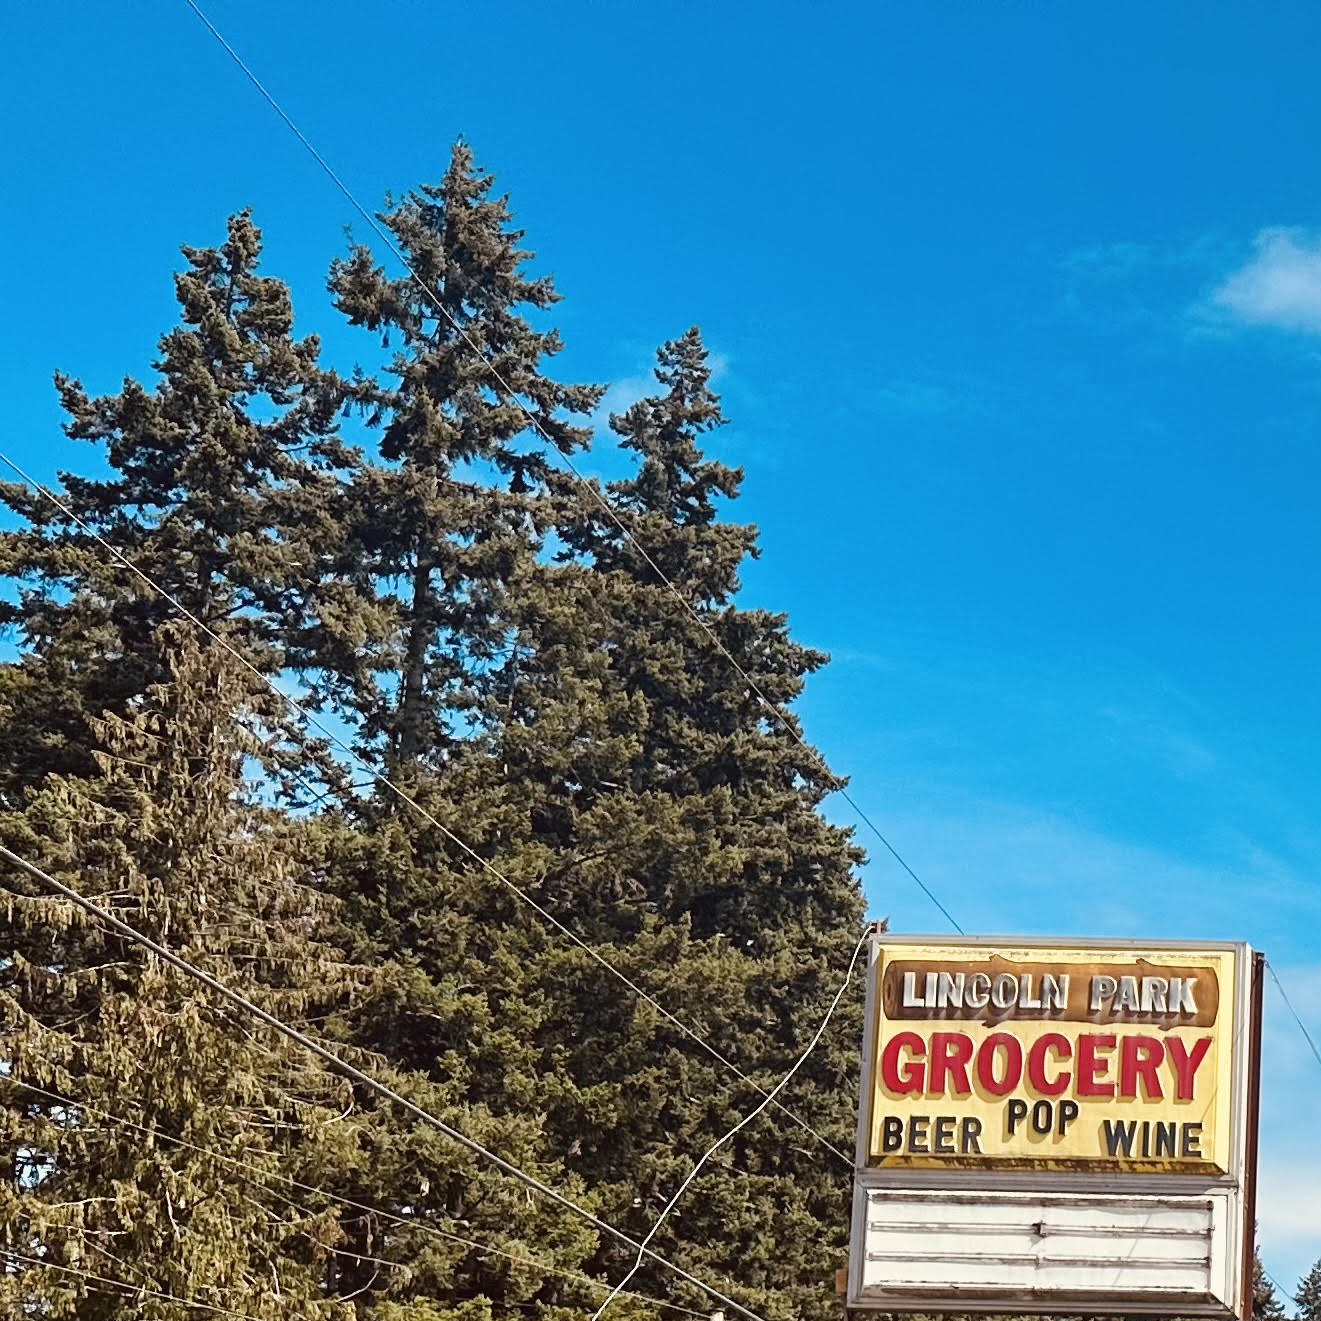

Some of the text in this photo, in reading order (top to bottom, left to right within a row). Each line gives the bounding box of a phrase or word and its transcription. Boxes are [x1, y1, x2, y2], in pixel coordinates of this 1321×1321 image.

[903, 971, 1198, 1014] LINCOLN PARK
[881, 1031, 1214, 1101] GROCERY
[883, 1098, 1204, 1159] BEER POP WINE
